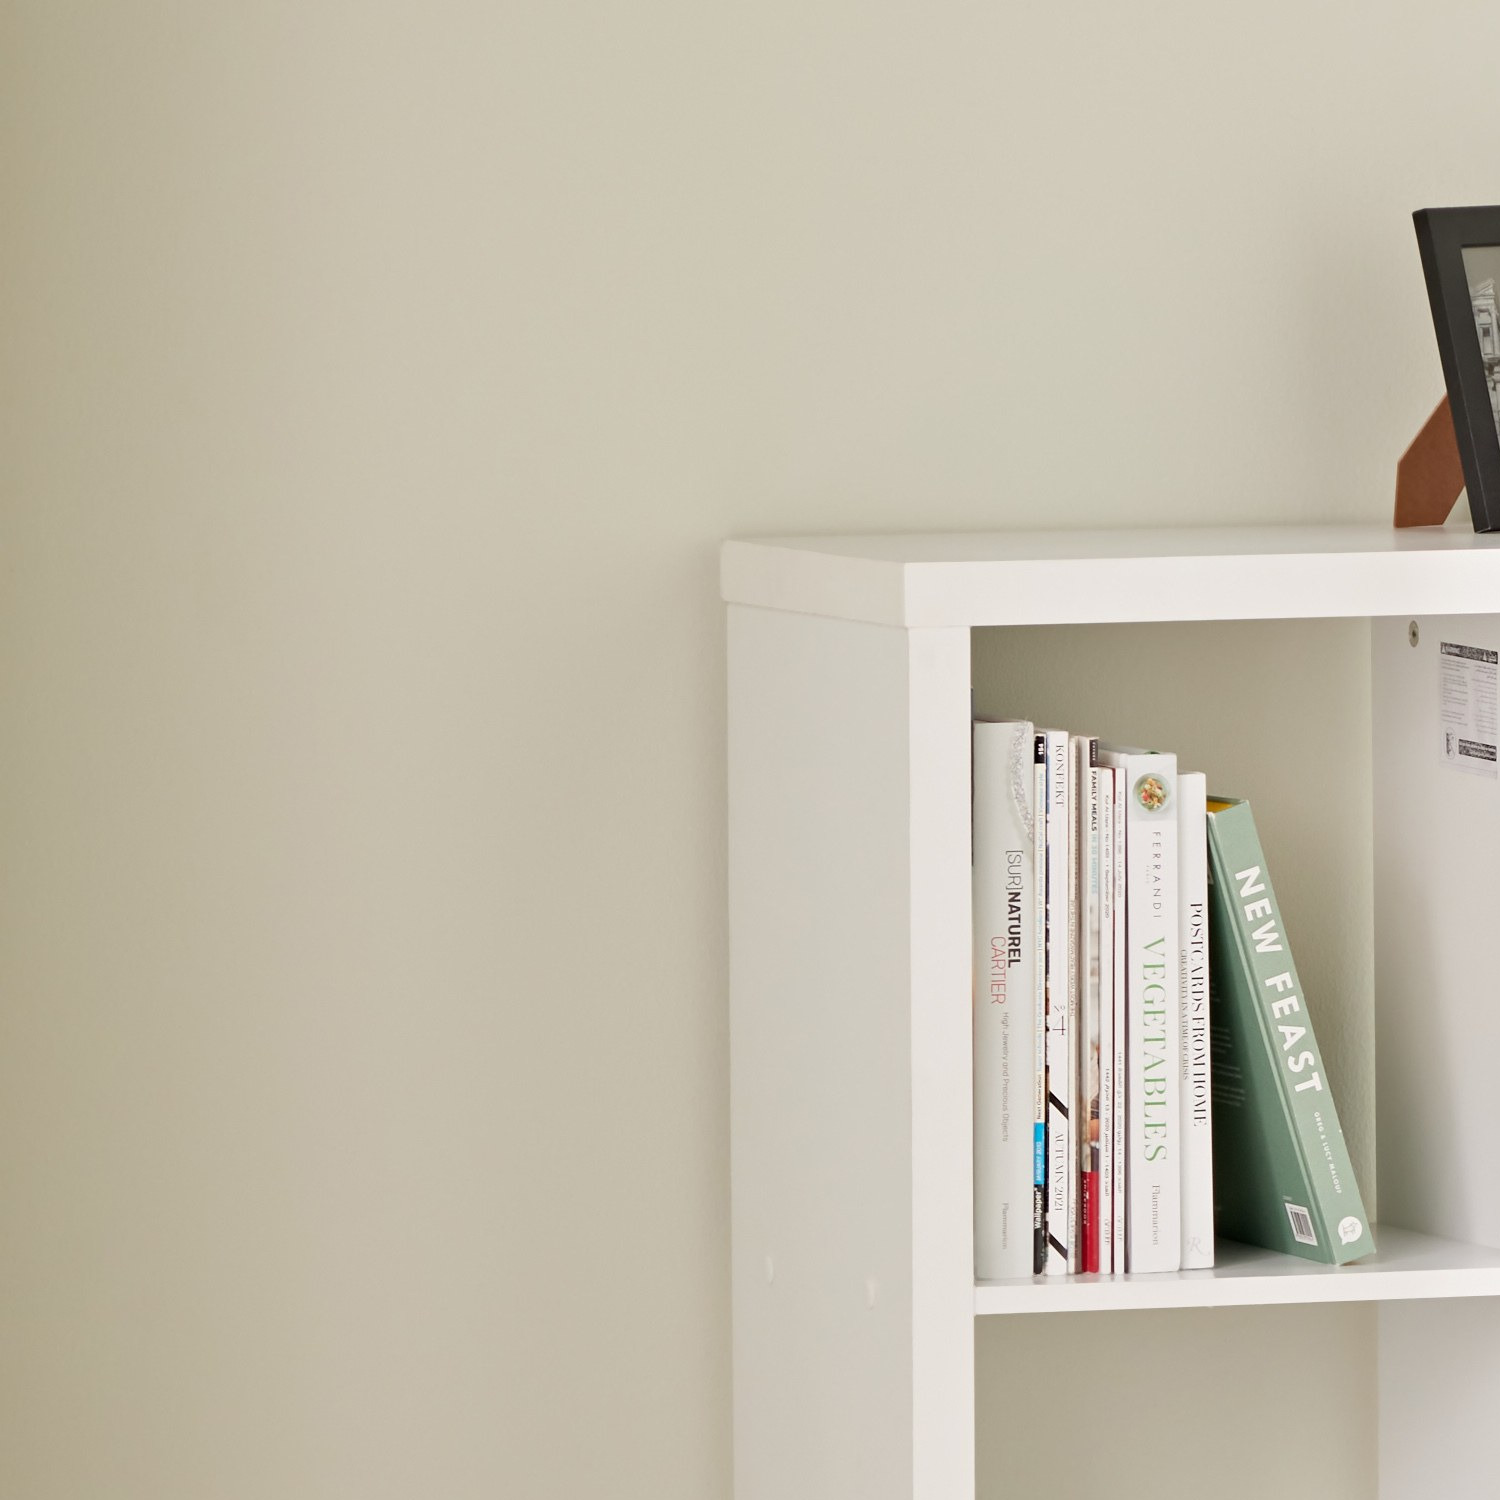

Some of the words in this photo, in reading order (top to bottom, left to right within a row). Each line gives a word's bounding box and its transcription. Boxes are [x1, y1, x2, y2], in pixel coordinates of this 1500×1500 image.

[1056, 745, 1064, 807] KONFEKT
[1153, 832, 1161, 918] FERRANDI
[991, 936, 1006, 1004] CARTIER
[1190, 903, 1204, 1012] POSTCARDS
[1235, 866, 1283, 952] NEW
[1265, 971, 1322, 1092] FEAST
[1181, 1002, 1187, 1011] IN
[1143, 936, 1167, 1162] VEGETABLES
[1182, 1041, 1188, 1052] OF
[1191, 1017, 1206, 1066] FROM
[1192, 1072, 1207, 1127] HOME
[1055, 1131, 1064, 1184] AUTUMN
[1314, 1112, 1325, 1132] GREG
[1322, 1142, 1332, 1160] LUCY
[1329, 1163, 1342, 1194] MALOUF
[1055, 1186, 1064, 1212] 2021
[1152, 1185, 1160, 1246] Flammarion
